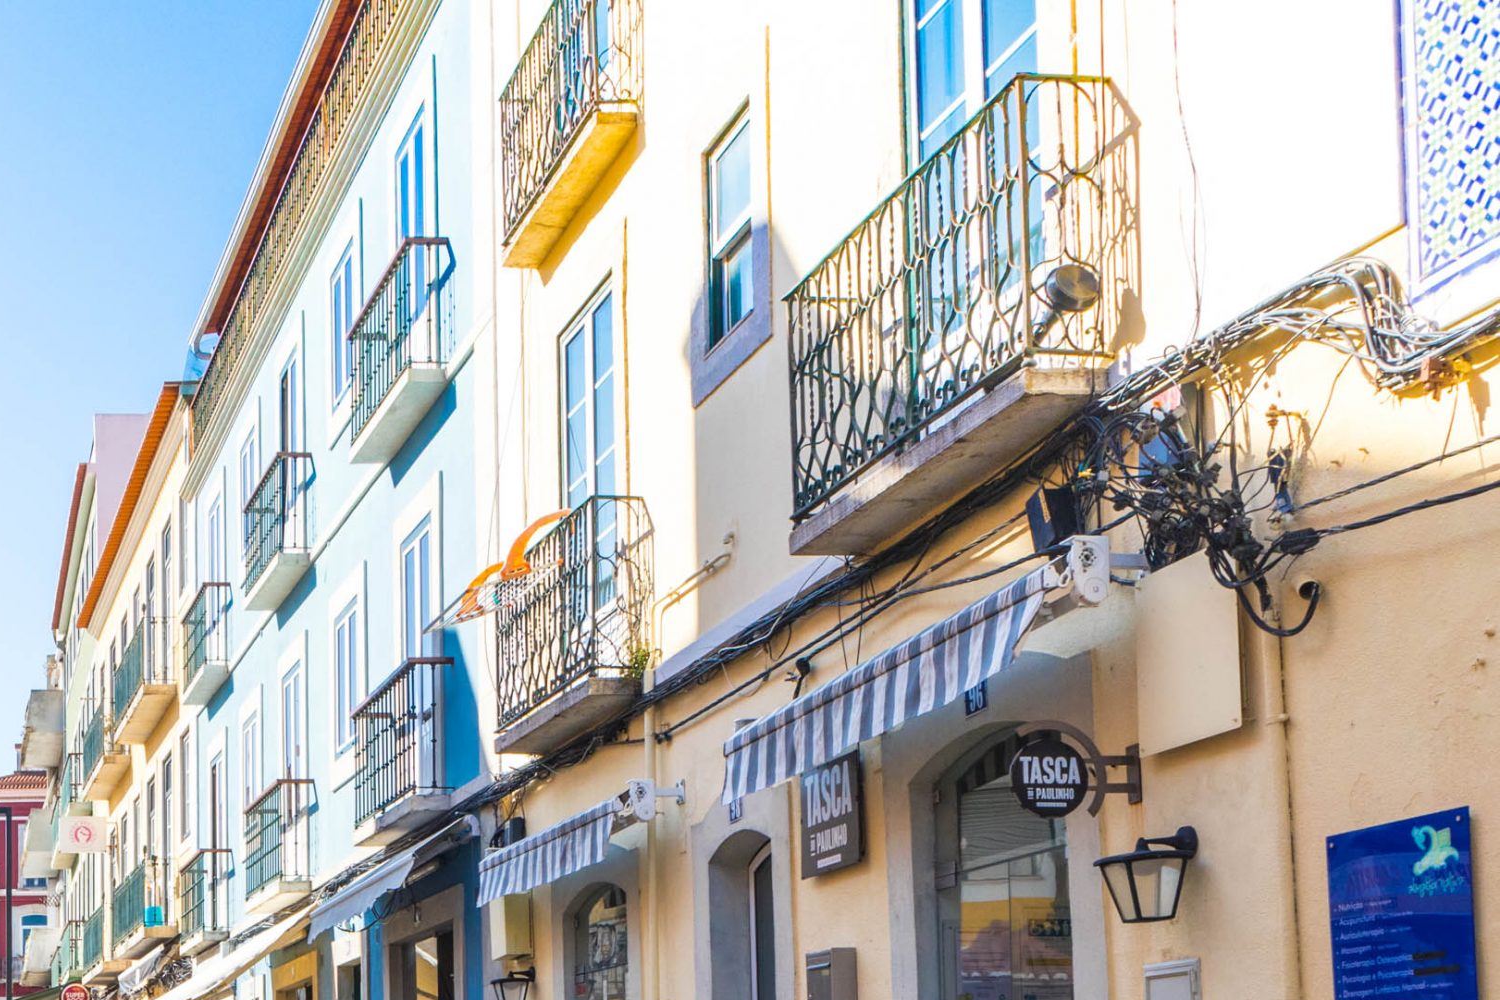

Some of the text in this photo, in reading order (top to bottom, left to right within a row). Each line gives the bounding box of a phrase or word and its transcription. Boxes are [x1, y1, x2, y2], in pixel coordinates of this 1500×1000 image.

[1019, 756, 1081, 785] TASCA
[804, 760, 853, 828] TASCA
[1035, 787, 1075, 800] PAULINHO
[816, 823, 848, 855] PAULINHO
